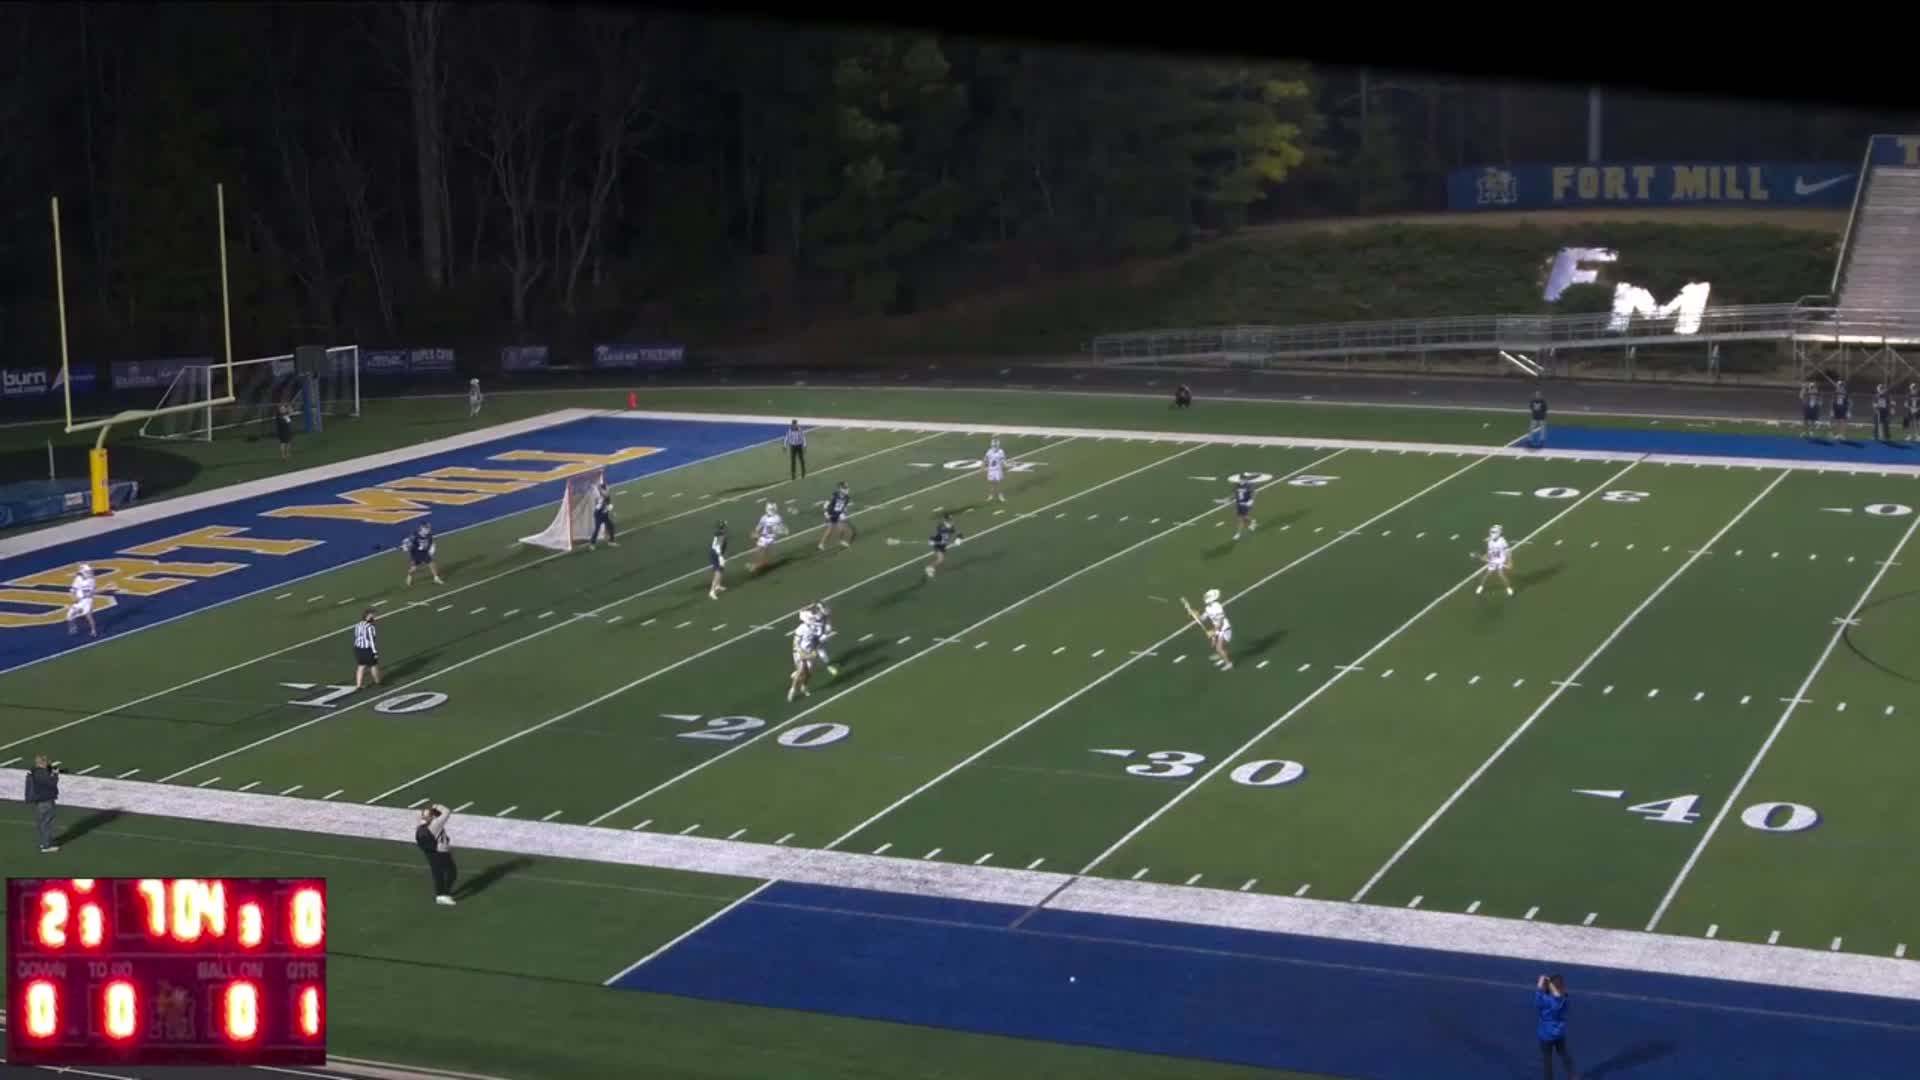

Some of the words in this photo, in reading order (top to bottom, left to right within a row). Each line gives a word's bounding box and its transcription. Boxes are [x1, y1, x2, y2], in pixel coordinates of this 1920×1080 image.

[1552, 165, 1656, 200] FORT
[1671, 165, 1769, 200] MILL
[2, 369, 47, 386] burn
[257, 446, 667, 524] MILL
